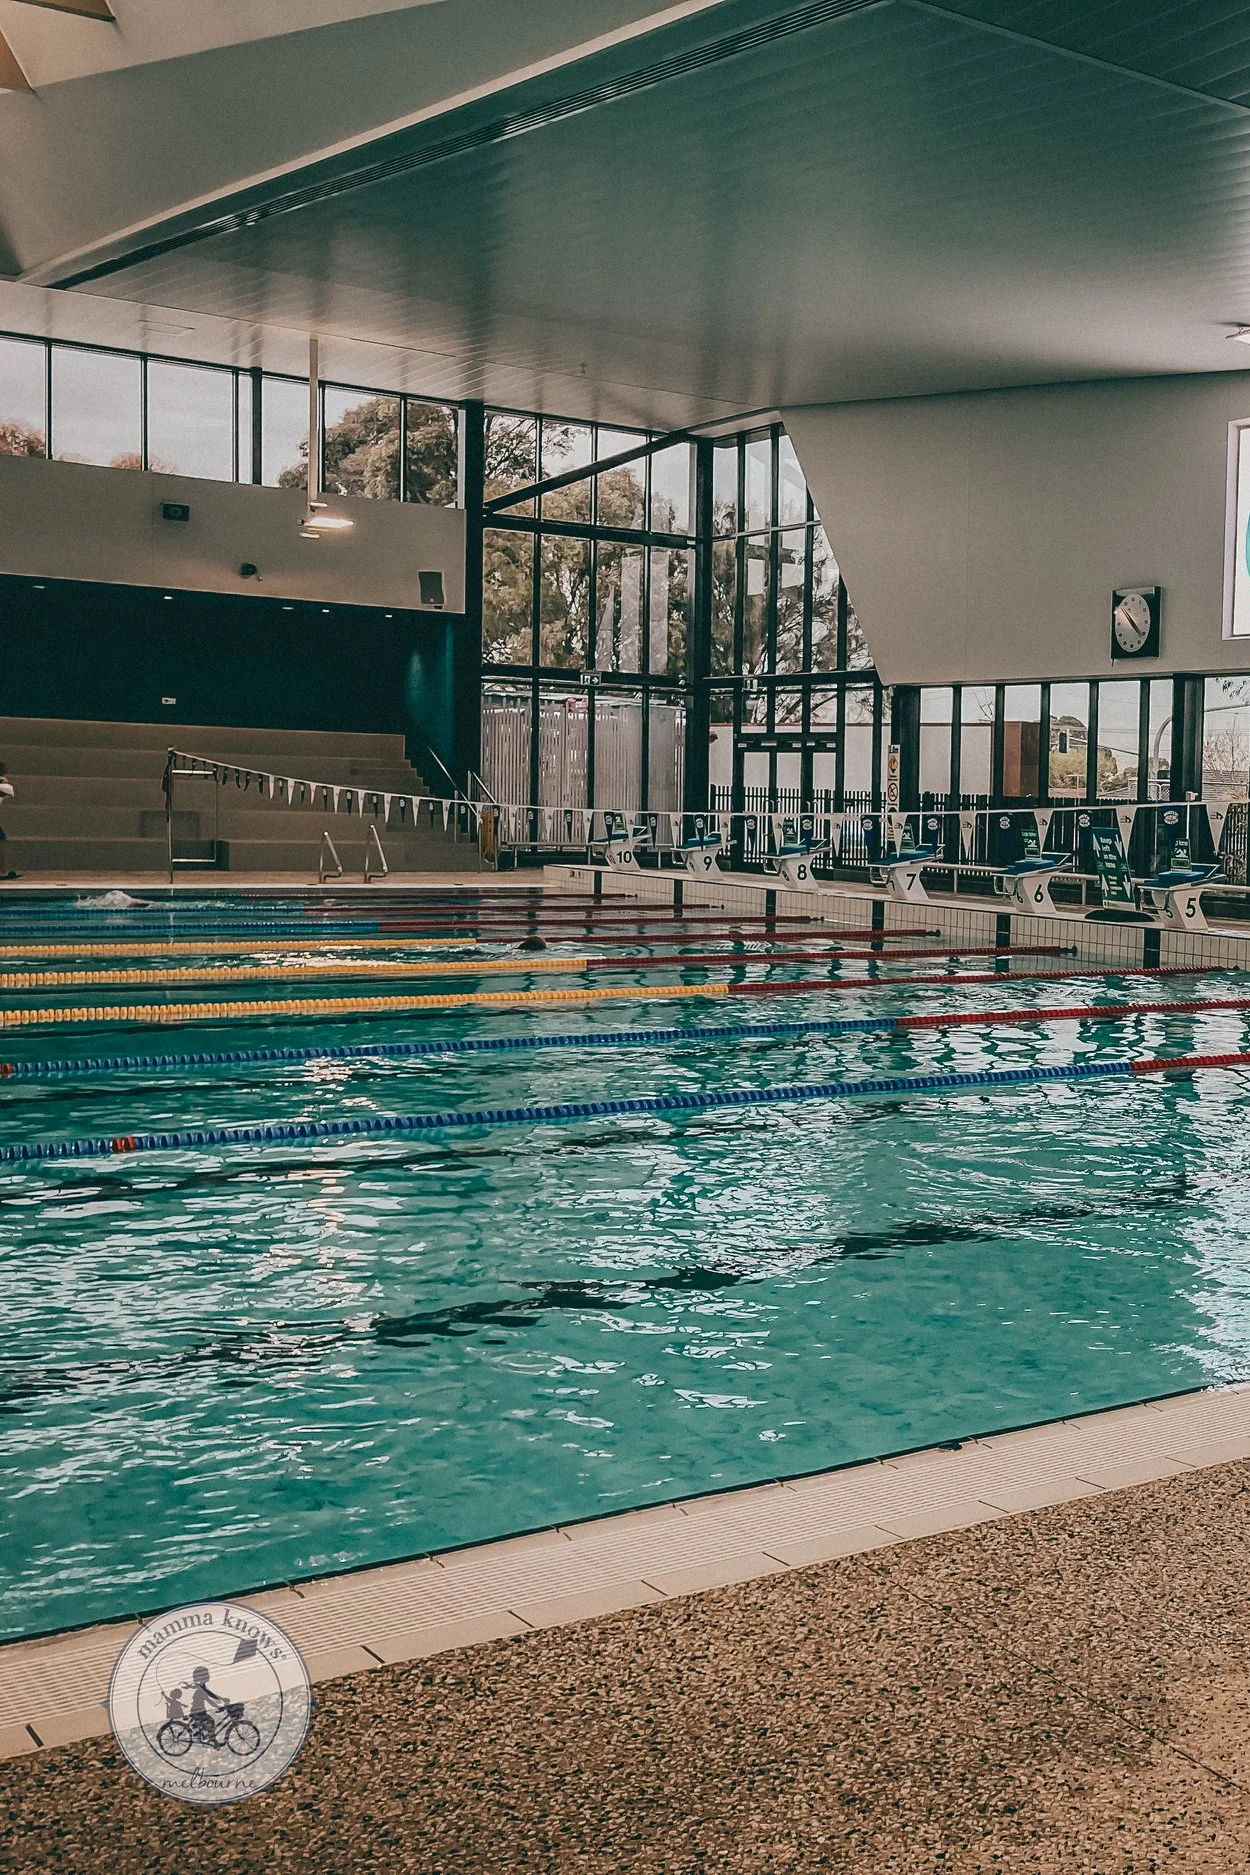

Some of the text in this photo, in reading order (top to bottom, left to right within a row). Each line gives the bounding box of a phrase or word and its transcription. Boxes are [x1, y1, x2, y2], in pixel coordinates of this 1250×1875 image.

[616, 850, 632, 863] 10
[703, 856, 712, 871] 9
[797, 864, 807, 881] 8
[906, 873, 917, 890] 7
[1034, 884, 1044, 903] 6
[1185, 898, 1196, 918] 5
